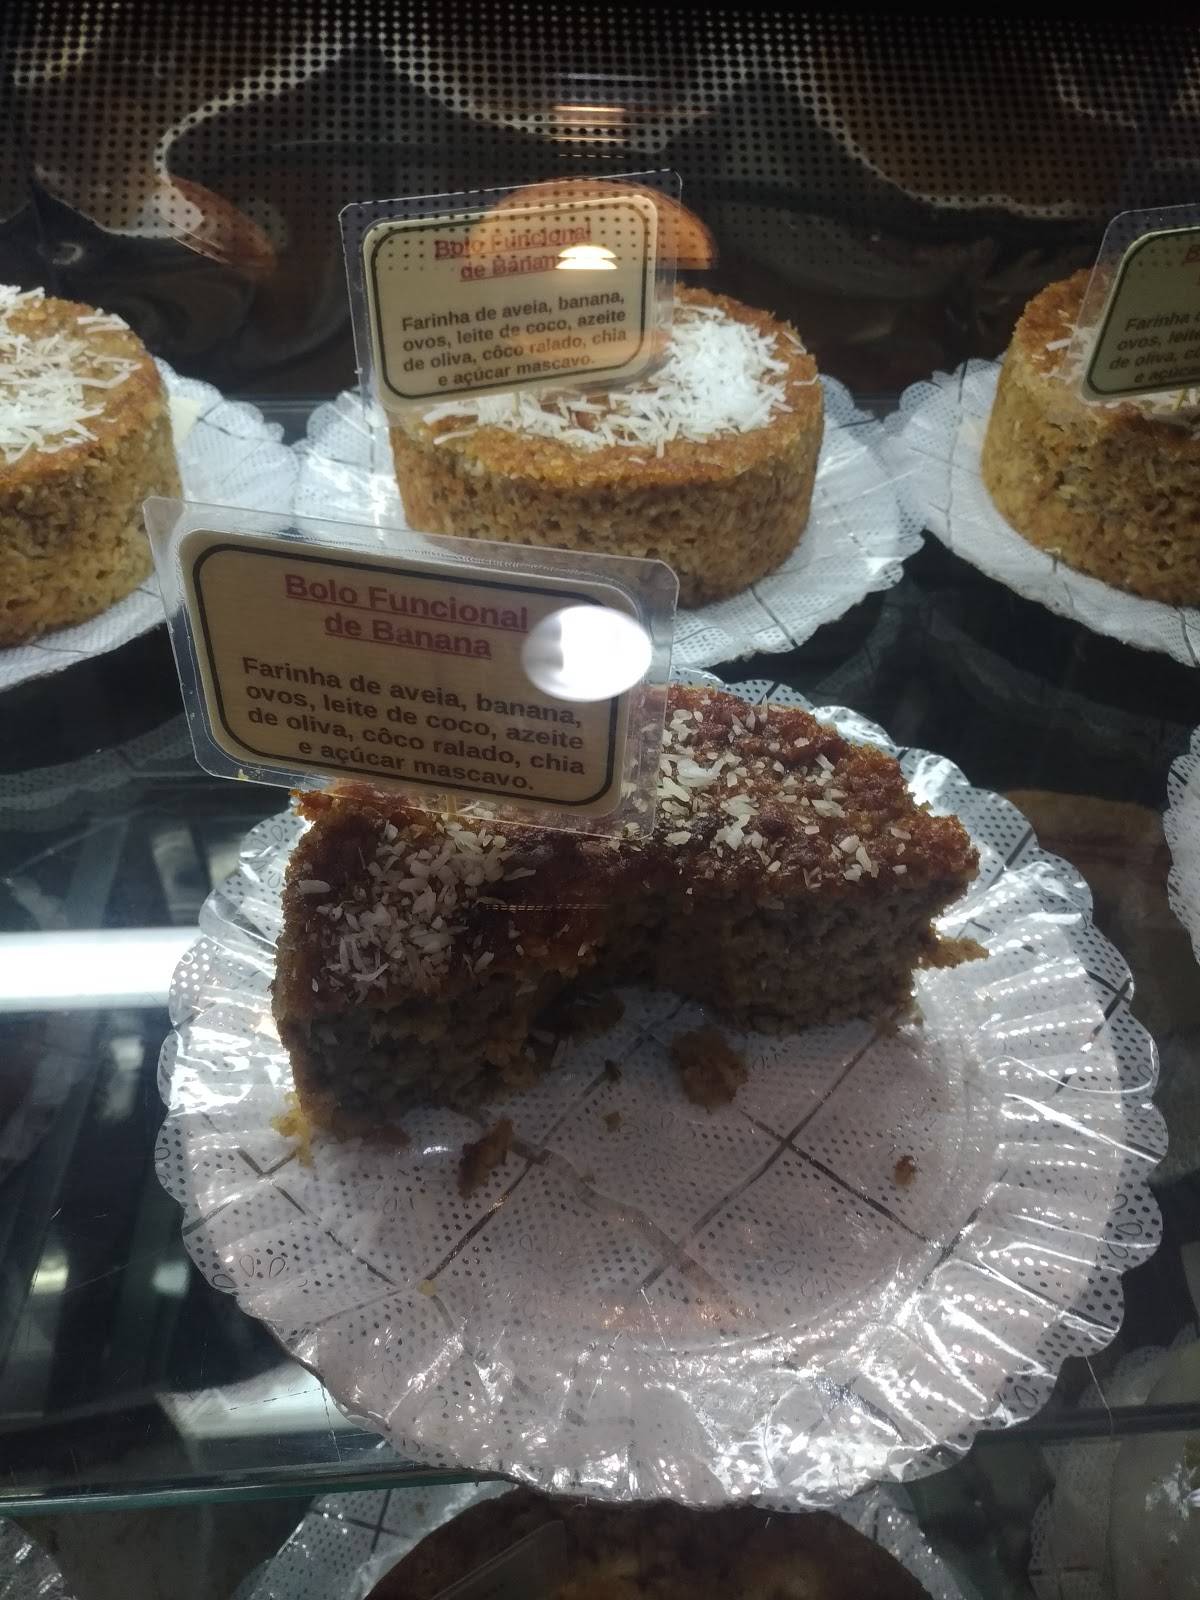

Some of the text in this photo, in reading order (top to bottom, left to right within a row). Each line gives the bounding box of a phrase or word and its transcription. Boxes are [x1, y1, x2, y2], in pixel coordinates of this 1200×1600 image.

[434, 222, 592, 259] Bolo Funcional
[460, 254, 558, 281] de Banan
[402, 291, 625, 332] Farinha de aveia, banana,
[402, 309, 626, 352] ovos, leite de coco, azeite
[1125, 312, 1190, 332] Farinha
[403, 328, 627, 372] de oliva, côco ralado, chia
[438, 354, 594, 387] e açúcar mascavo.
[1109, 356, 1130, 370] de
[284, 574, 529, 633] Bolo Funcional
[324, 612, 492, 660] de Banana
[242, 656, 582, 728] Farinha de aveia, banana,
[246, 685, 584, 749] ovos, leite de coco, azeite
[248, 707, 585, 775] de oliva, côco ralado, chia
[299, 740, 534, 791] e açúcar mascavo.
